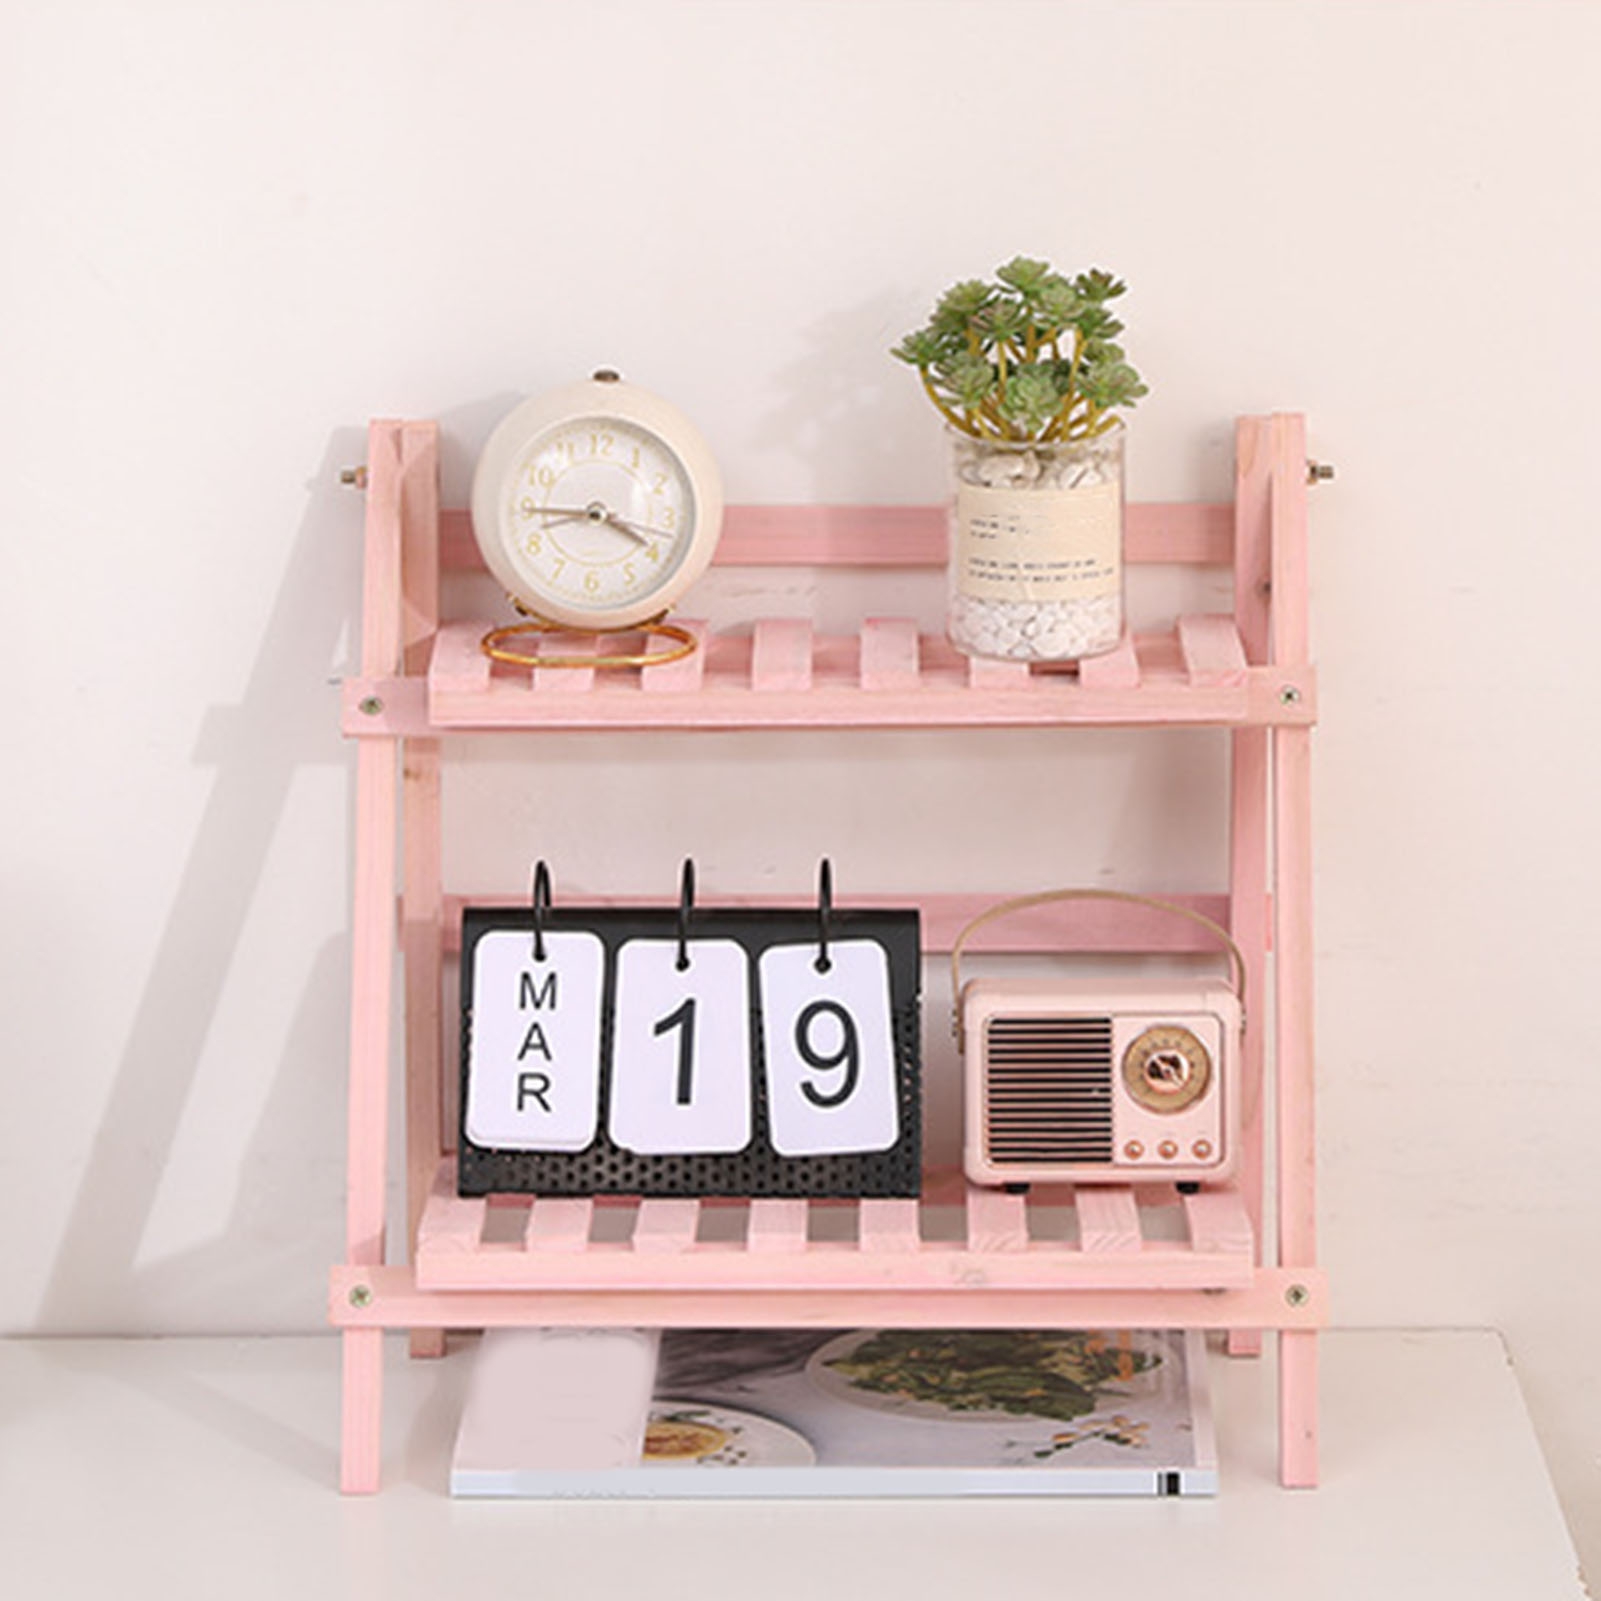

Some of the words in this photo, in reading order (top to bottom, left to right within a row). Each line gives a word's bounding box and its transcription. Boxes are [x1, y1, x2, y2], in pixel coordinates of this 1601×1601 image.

[590, 432, 615, 456] 12
[632, 447, 641, 469] 1
[528, 464, 555, 488] 10
[652, 472, 668, 496] 2
[521, 496, 536, 522] 9
[662, 505, 675, 530] 3
[526, 532, 542, 555] 8
[645, 541, 660, 563] 4
[553, 557, 566, 580] 7
[623, 562, 637, 586] 5
[584, 569, 600, 593] 6
[516, 971, 558, 1113] MAR
[653, 997, 697, 1106] 1
[794, 1000, 860, 1108] 9
